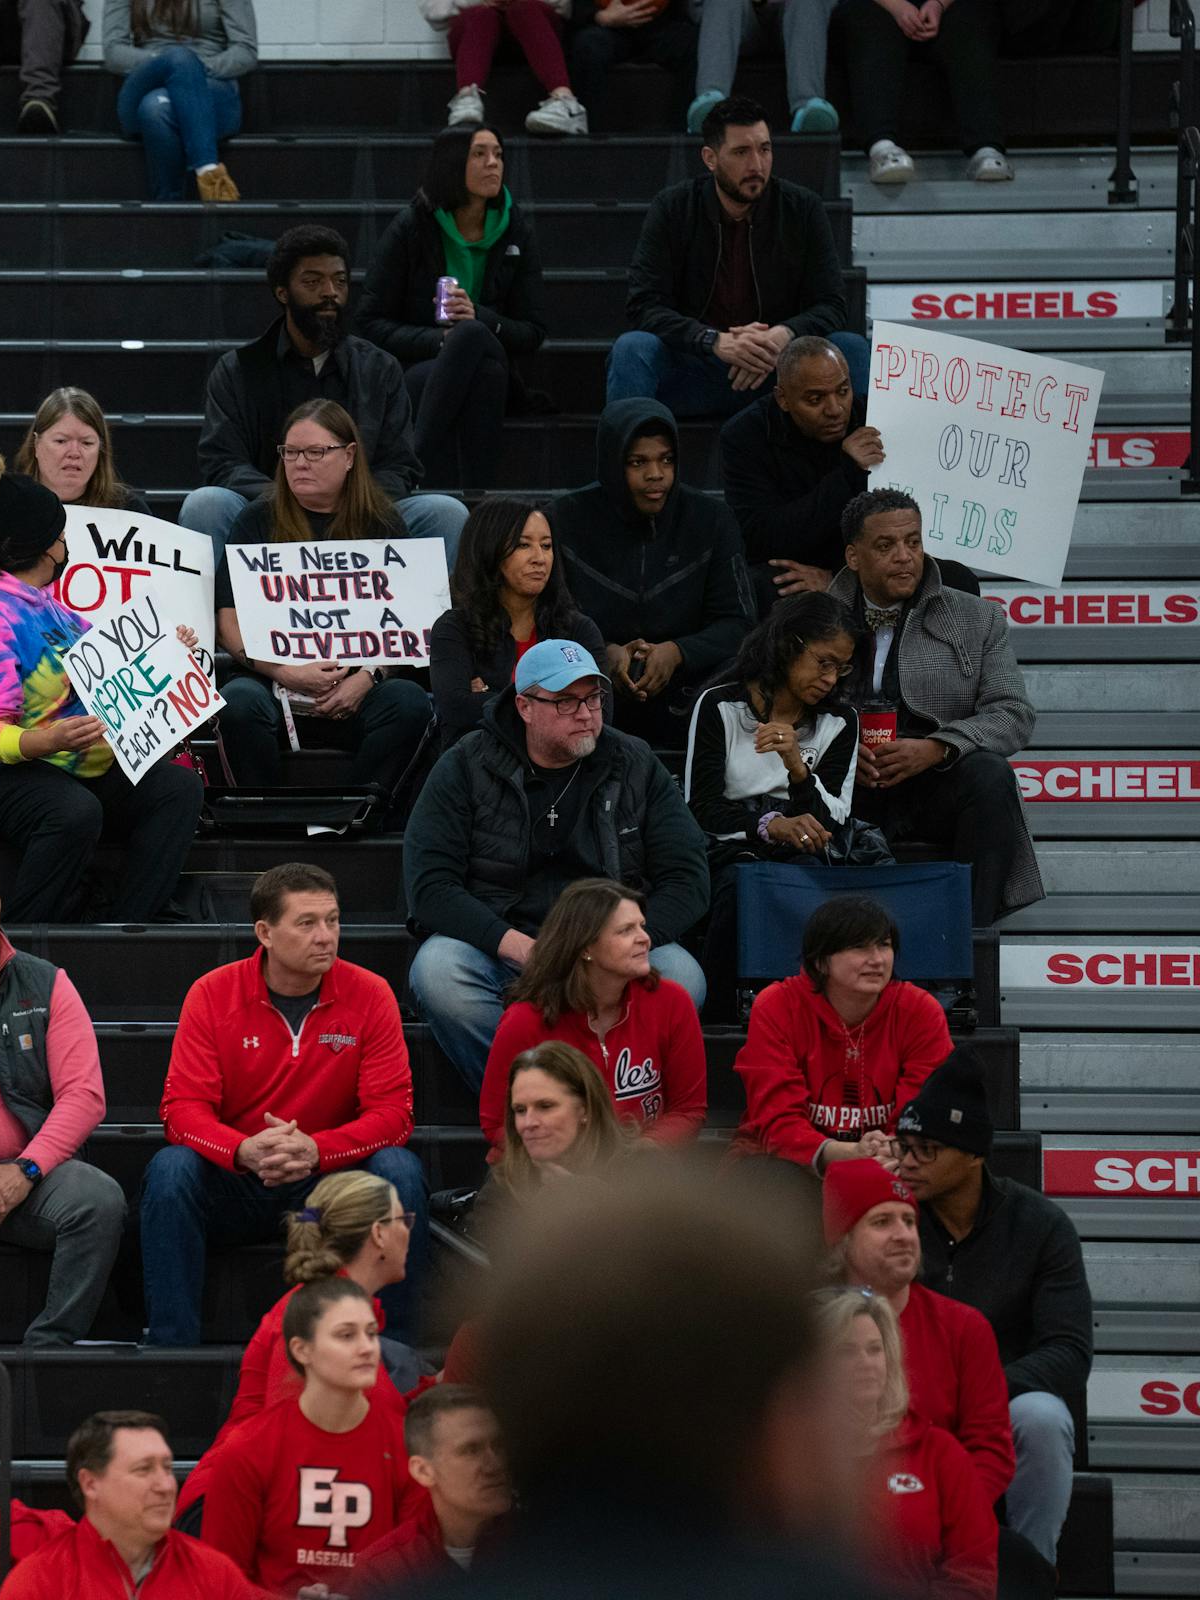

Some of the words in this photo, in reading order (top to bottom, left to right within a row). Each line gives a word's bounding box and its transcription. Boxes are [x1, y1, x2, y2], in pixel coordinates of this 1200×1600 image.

[911, 291, 1118, 320] SCHEELS
[874, 344, 1089, 433] PROTECT
[938, 424, 1030, 488] OUR
[888, 481, 1017, 556] IDS
[87, 523, 201, 575] WILL
[237, 546, 282, 572] WE
[300, 546, 370, 571] NEED
[384, 544, 406, 568] A
[52, 563, 151, 612] OT
[260, 570, 394, 603] UNITER
[289, 607, 350, 629] NOT
[380, 607, 403, 628] A
[69, 641, 105, 693] DO
[99, 596, 160, 662] YOU
[167, 653, 220, 728] NO!
[1047, 953, 1200, 986] SCHE
[296, 1466, 372, 1548] EP
[296, 1548, 358, 1567] BASEBAL
